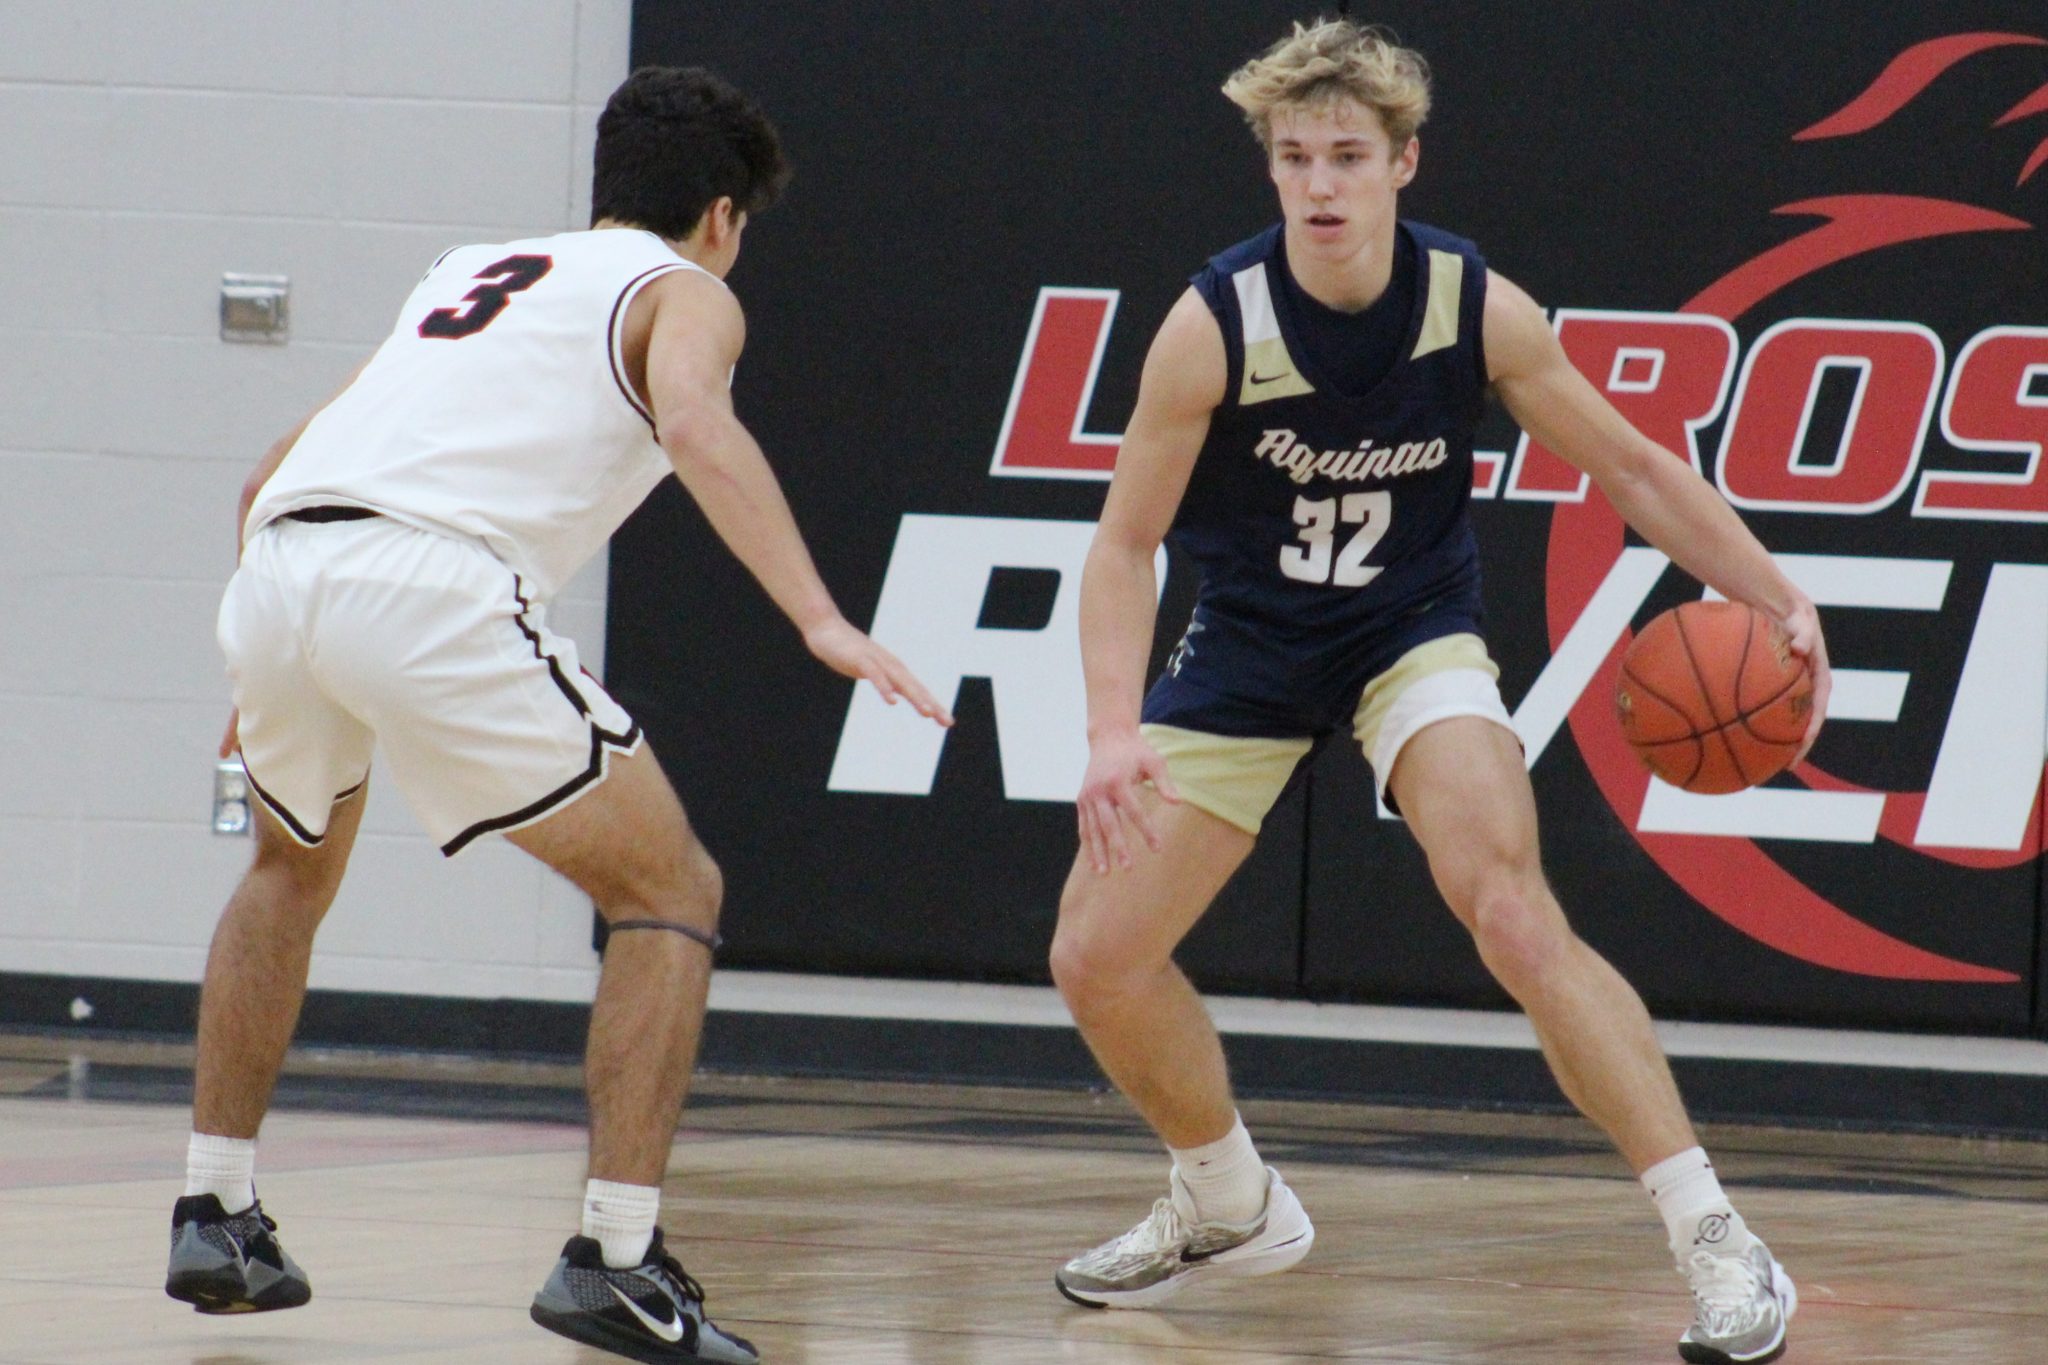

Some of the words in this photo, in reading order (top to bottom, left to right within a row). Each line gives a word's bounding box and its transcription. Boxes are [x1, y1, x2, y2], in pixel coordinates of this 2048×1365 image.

[417, 254, 554, 340] 3
[1254, 428, 1449, 485] Aquinas
[1464, 307, 2048, 523] ROS
[1279, 490, 1392, 588] 32
